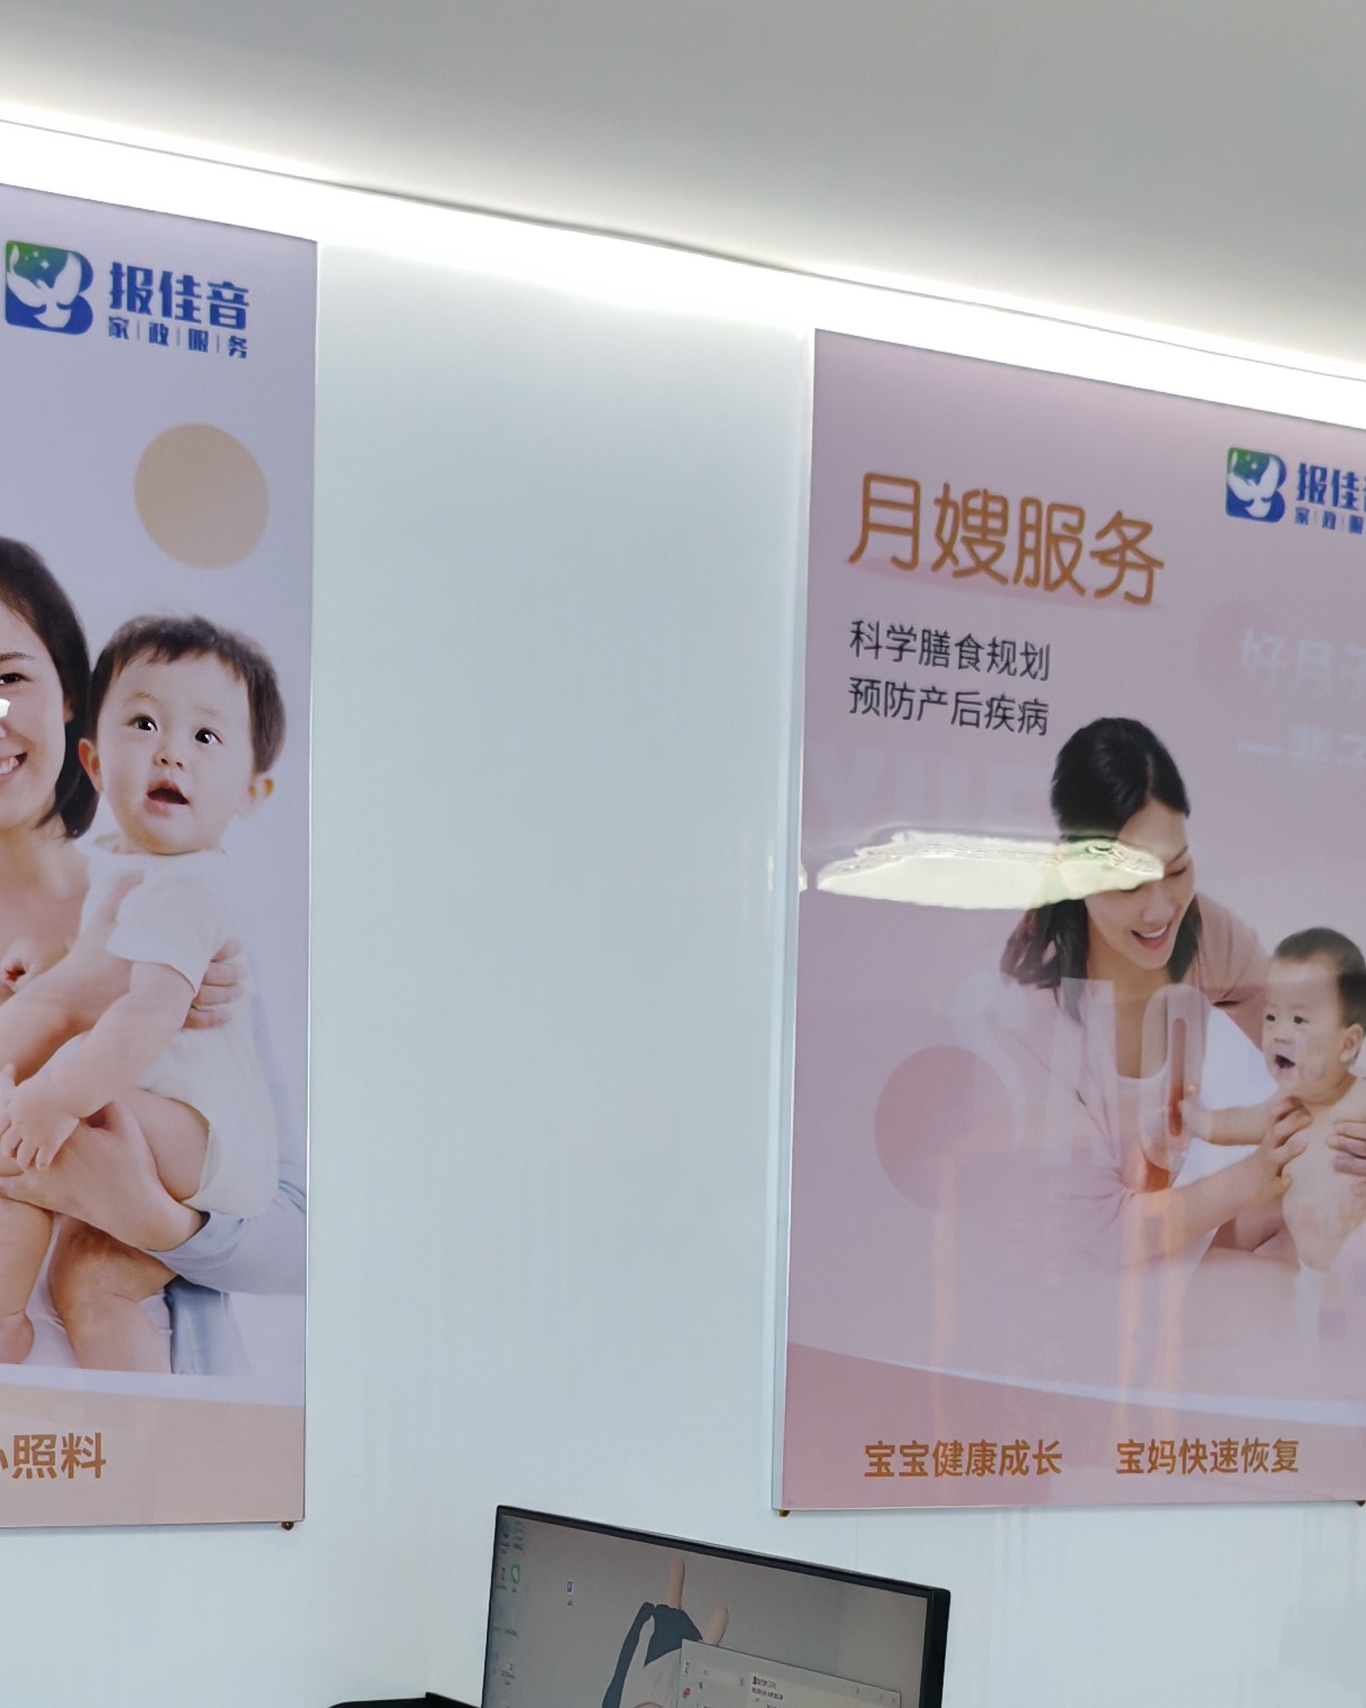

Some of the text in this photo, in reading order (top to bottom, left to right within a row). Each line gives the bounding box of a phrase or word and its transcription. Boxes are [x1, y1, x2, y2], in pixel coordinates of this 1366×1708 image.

[108, 261, 250, 330] 报佳音
[847, 471, 1165, 606] 月嫂服务
[849, 619, 1051, 683] 科学膳食规划
[848, 677, 1050, 737] 预防产后疾病
[864, 1437, 1300, 1479] 宝宝健康成长 宝妈快速恢复
